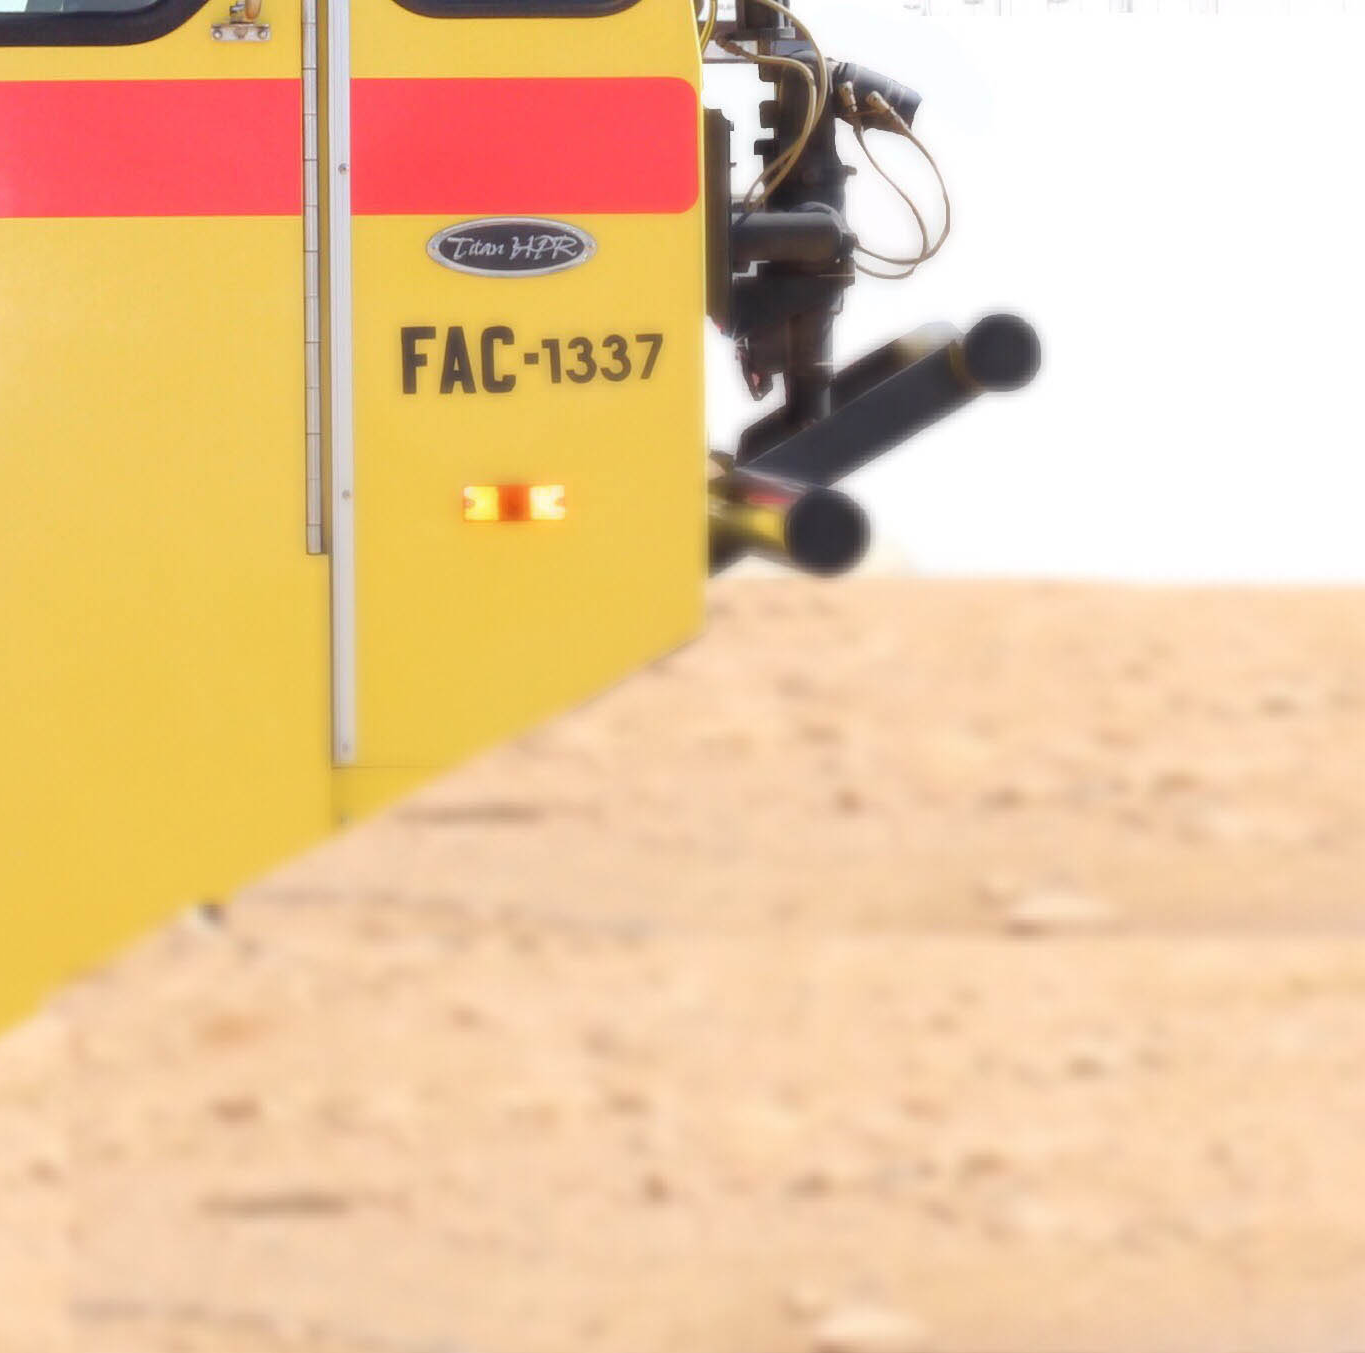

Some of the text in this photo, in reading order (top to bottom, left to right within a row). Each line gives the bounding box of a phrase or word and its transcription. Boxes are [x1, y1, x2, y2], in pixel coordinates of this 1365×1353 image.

[447, 233, 579, 261] Titan HPR
[399, 325, 664, 395] FAC-1337
